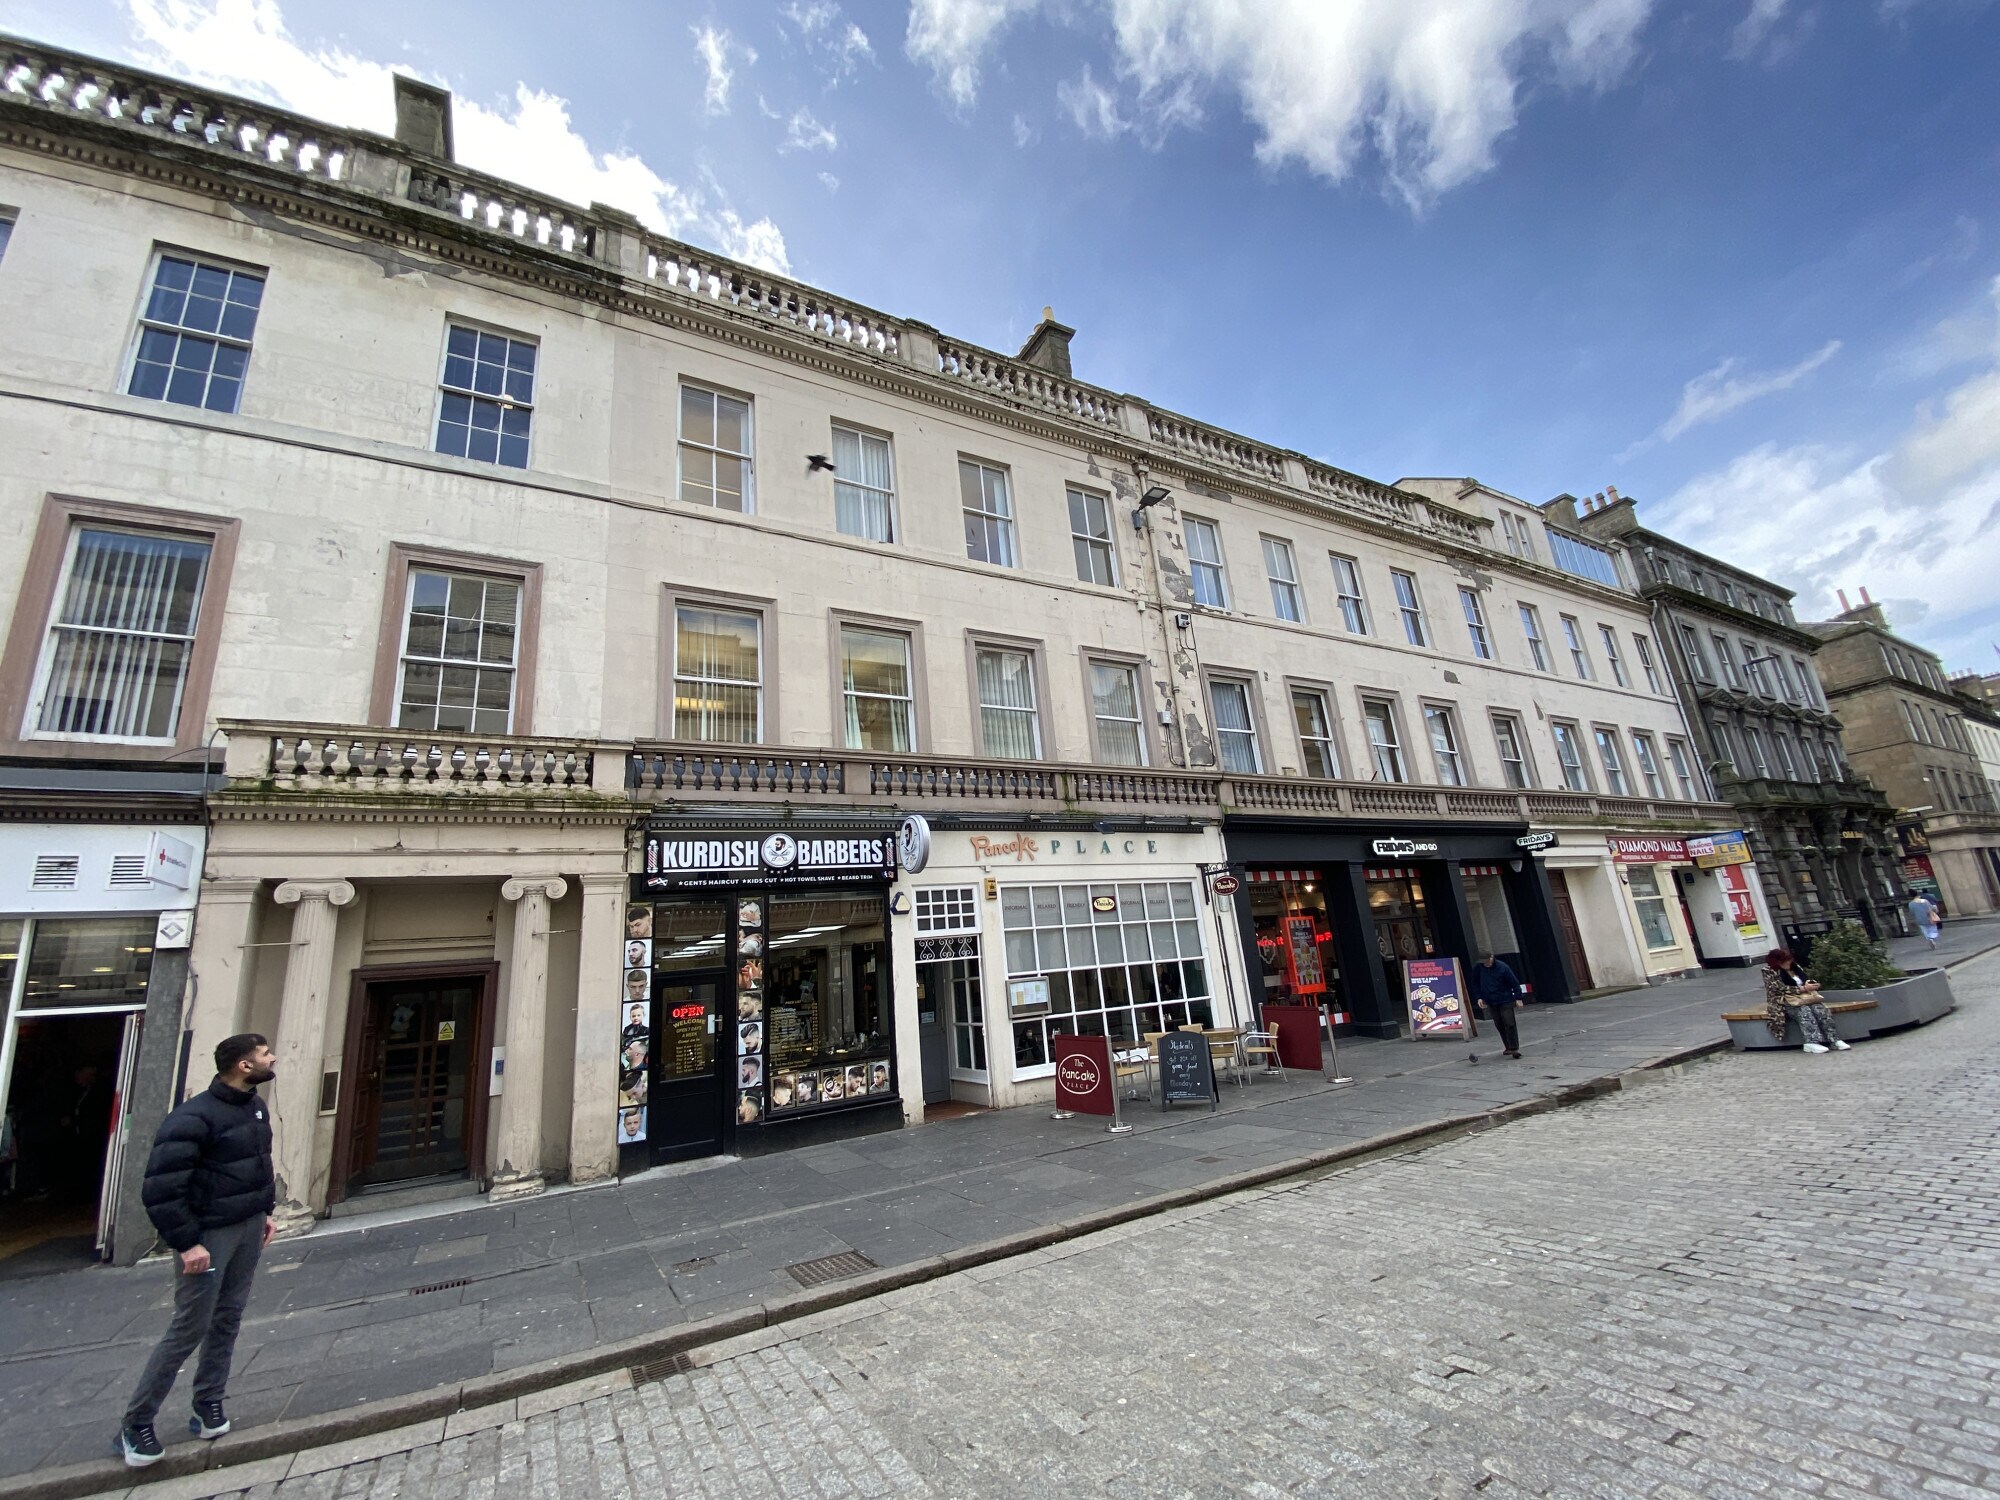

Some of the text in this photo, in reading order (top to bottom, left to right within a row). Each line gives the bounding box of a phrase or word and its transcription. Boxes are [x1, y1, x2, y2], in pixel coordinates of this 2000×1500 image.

[1518, 833, 1551, 845] FRIDAYS
[970, 832, 1158, 862] Pancake PLACE
[1376, 842, 1438, 853] FRIDAYS AND GO
[1619, 840, 1684, 853] DIAMOND NAILS
[1688, 842, 1714, 857] DIAMOND NAILS
[1718, 842, 1747, 854] LET
[663, 839, 884, 868] KURDISH BARBERS
[672, 1006, 705, 1018] OPEN
[672, 1018, 707, 1029] WELCOME
[1169, 1040, 1194, 1050] Students
[1074, 1058, 1085, 1067] The
[1171, 1062, 1198, 1074] your food
[1061, 1067, 1096, 1083] Pancake
[1066, 1081, 1090, 1090] PLACE
[1170, 1080, 1194, 1091] Monday
